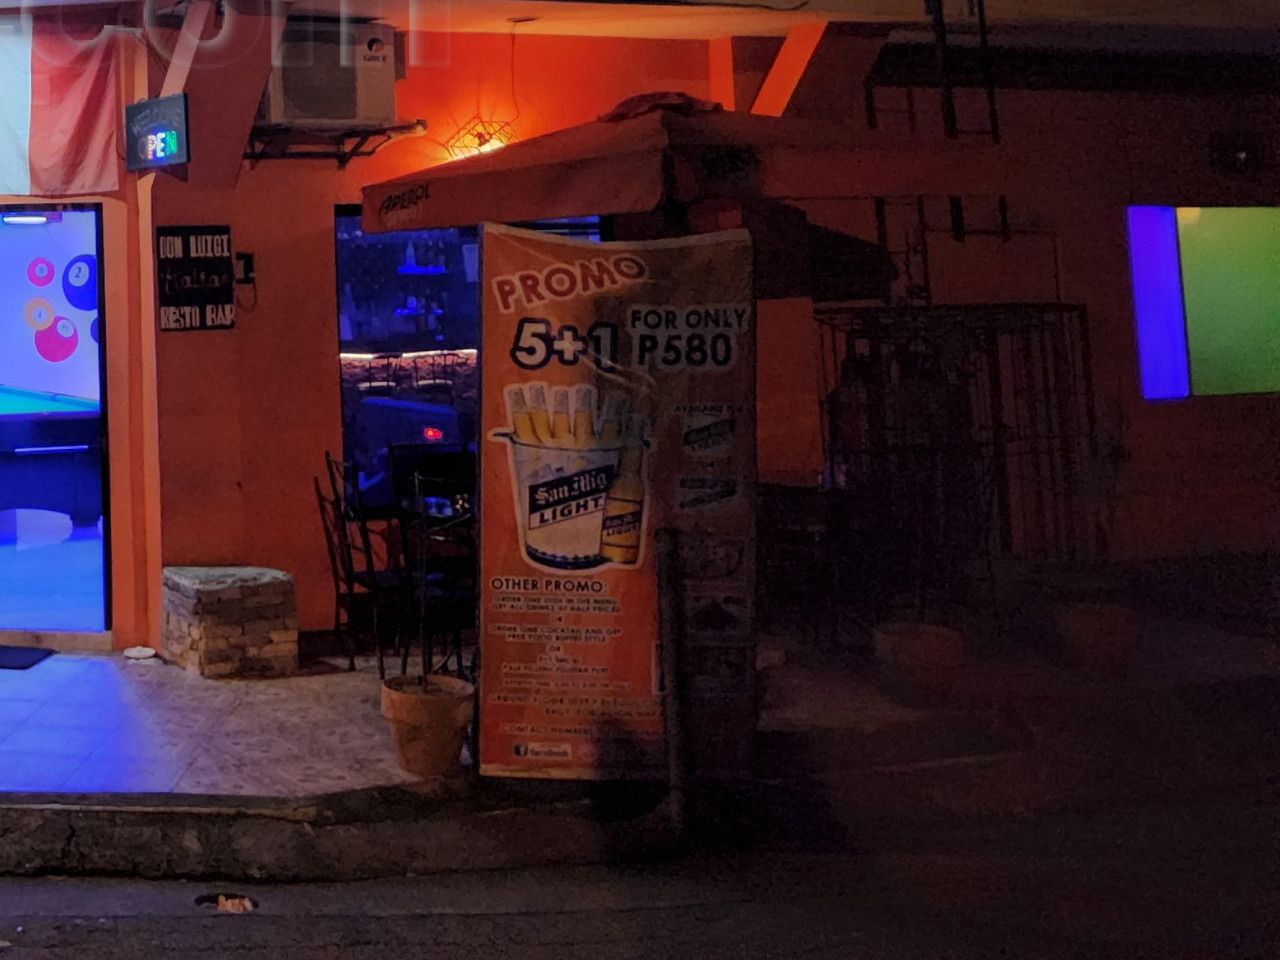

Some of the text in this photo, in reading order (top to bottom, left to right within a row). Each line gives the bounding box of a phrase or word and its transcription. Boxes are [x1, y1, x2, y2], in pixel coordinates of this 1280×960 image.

[159, 234, 231, 259] DON LUIGI
[495, 256, 647, 311] PROMO
[160, 304, 236, 329] RESTO BAR
[631, 308, 747, 328] FOR ONLY
[510, 316, 618, 373] 5+1
[638, 332, 732, 367] P580
[534, 470, 608, 505] San Mig
[539, 495, 602, 524] LIGHT
[491, 577, 539, 591] OTHER
